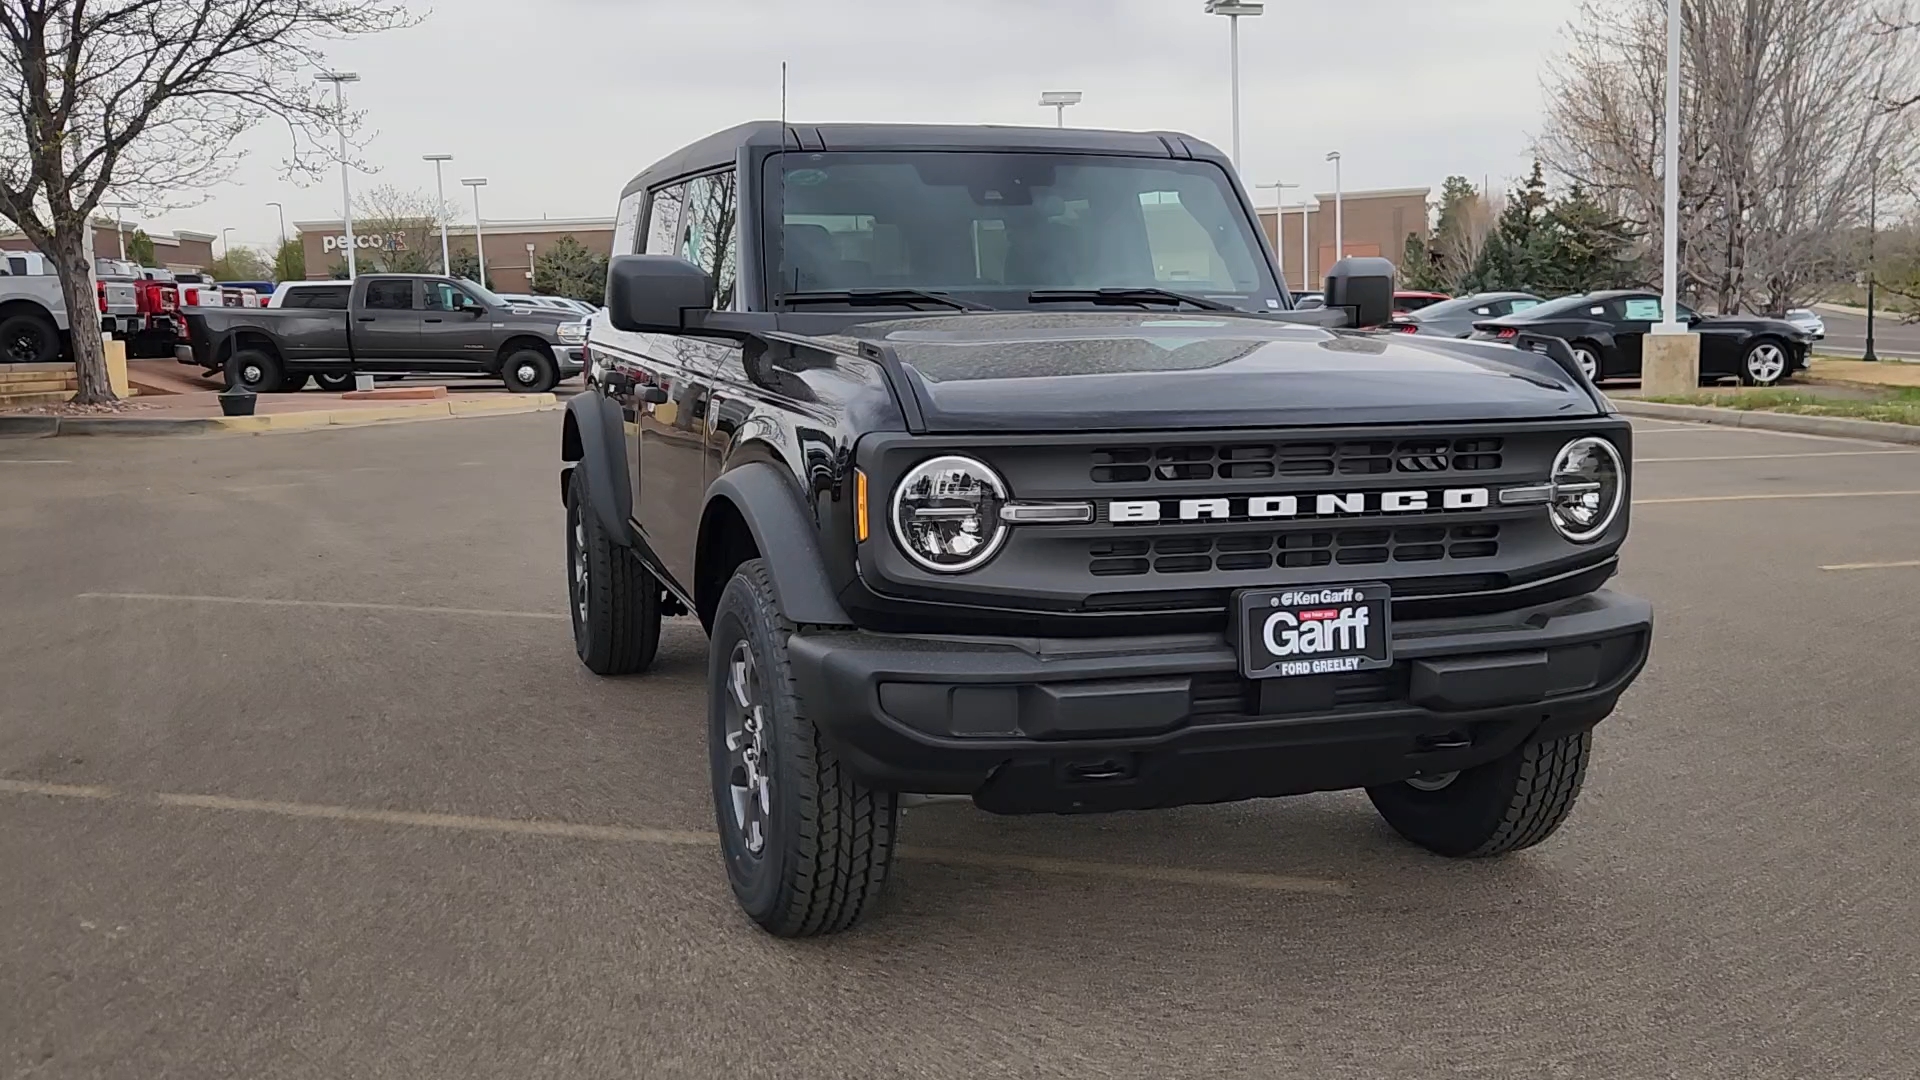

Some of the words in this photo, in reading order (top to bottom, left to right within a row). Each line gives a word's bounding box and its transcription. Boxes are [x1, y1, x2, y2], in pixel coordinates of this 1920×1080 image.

[1109, 488, 1489, 522] BRONCO
[1292, 591, 1319, 605] Ken
[1320, 588, 1354, 603] Garff
[1263, 606, 1369, 656] Garff
[1281, 661, 1311, 676] FORD
[1312, 657, 1360, 674] GREELEY
